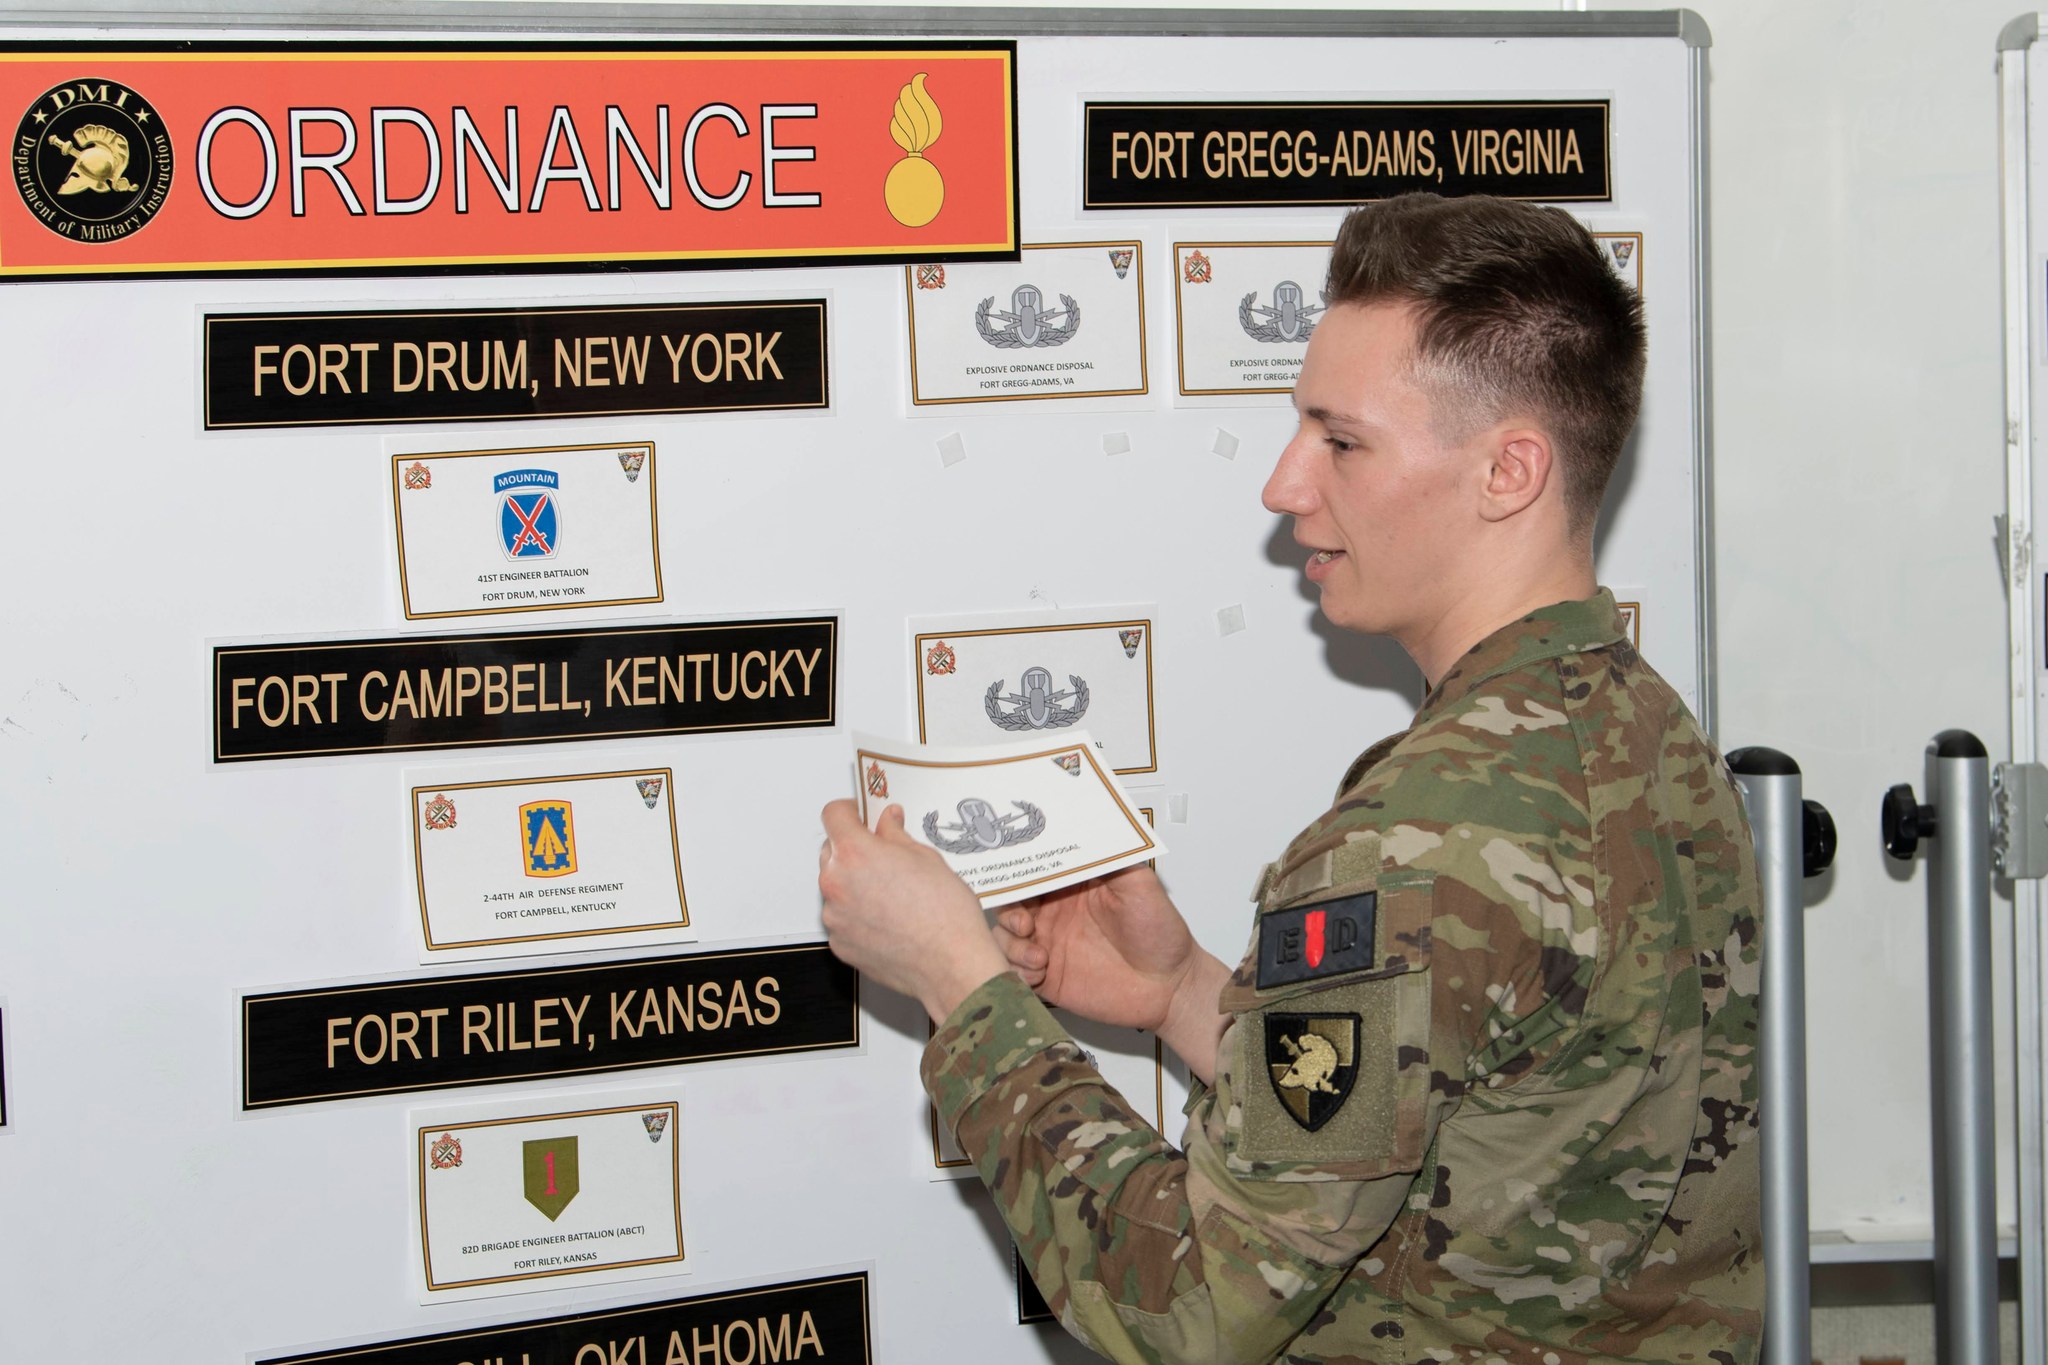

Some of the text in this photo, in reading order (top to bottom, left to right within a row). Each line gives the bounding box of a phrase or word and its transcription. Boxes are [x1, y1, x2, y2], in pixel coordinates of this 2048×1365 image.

[49, 84, 132, 111] DMI
[196, 102, 822, 219] ORDNANCE
[1112, 129, 1584, 183] FORT GREGG-ADAMS, VIRGINIA
[14, 134, 171, 240] Department of Military Instruction
[254, 331, 784, 397] FORT DRUM, NEW YORK
[966, 361, 1094, 375] EXPLOSIVE ORDNANCE DISPOSAL
[1230, 358, 1304, 367] EXPLOSIVE ORDNAN
[980, 377, 1074, 389] FORT GREGG-ADAMS, VA
[1264, 372, 1300, 380] GREGG-AD
[498, 473, 555, 488] MOUNTAIN
[477, 568, 589, 583] 41ST ENGINEER BATTALION
[482, 587, 585, 601] FORT DRUM, NEW YORK
[232, 648, 823, 729] FORT CAMPBELL, KENTUCKY
[981, 843, 1081, 873] ORDNANCE DISPOSAL
[483, 883, 624, 902] 2-44TH AIR DEFENSE REGIMENT
[495, 902, 616, 919] FORT CAMPBELL, KENTUCKY
[327, 976, 781, 1068] FORT RILEY, KANSAS
[544, 1151, 559, 1195] 1
[462, 1225, 645, 1254] 82D BRIGADE ENGINEER BATTALION (ABCT)
[514, 1252, 597, 1269] FORT RILEY, KANSAS
